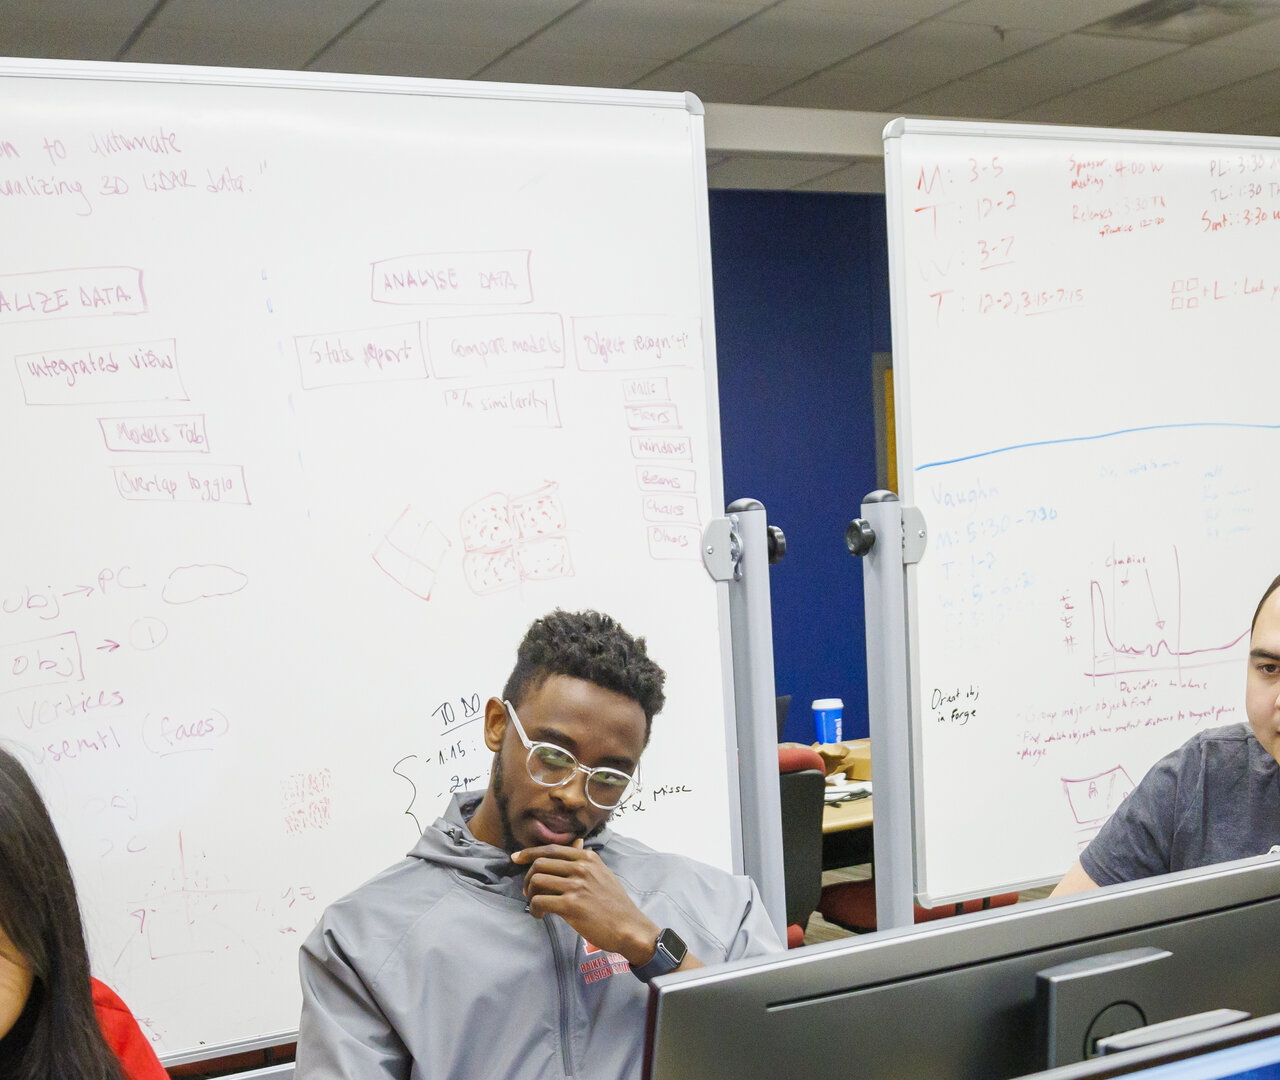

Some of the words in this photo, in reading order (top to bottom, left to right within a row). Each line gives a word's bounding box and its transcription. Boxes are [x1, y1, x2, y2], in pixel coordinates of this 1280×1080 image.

[42, 134, 67, 166] to
[88, 125, 183, 157] automate
[99, 174, 130, 197] 3D
[383, 267, 459, 291] ANALYSE
[79, 285, 131, 308] DATA
[580, 956, 608, 974] RAIKES
[584, 966, 613, 985] DESIGN
